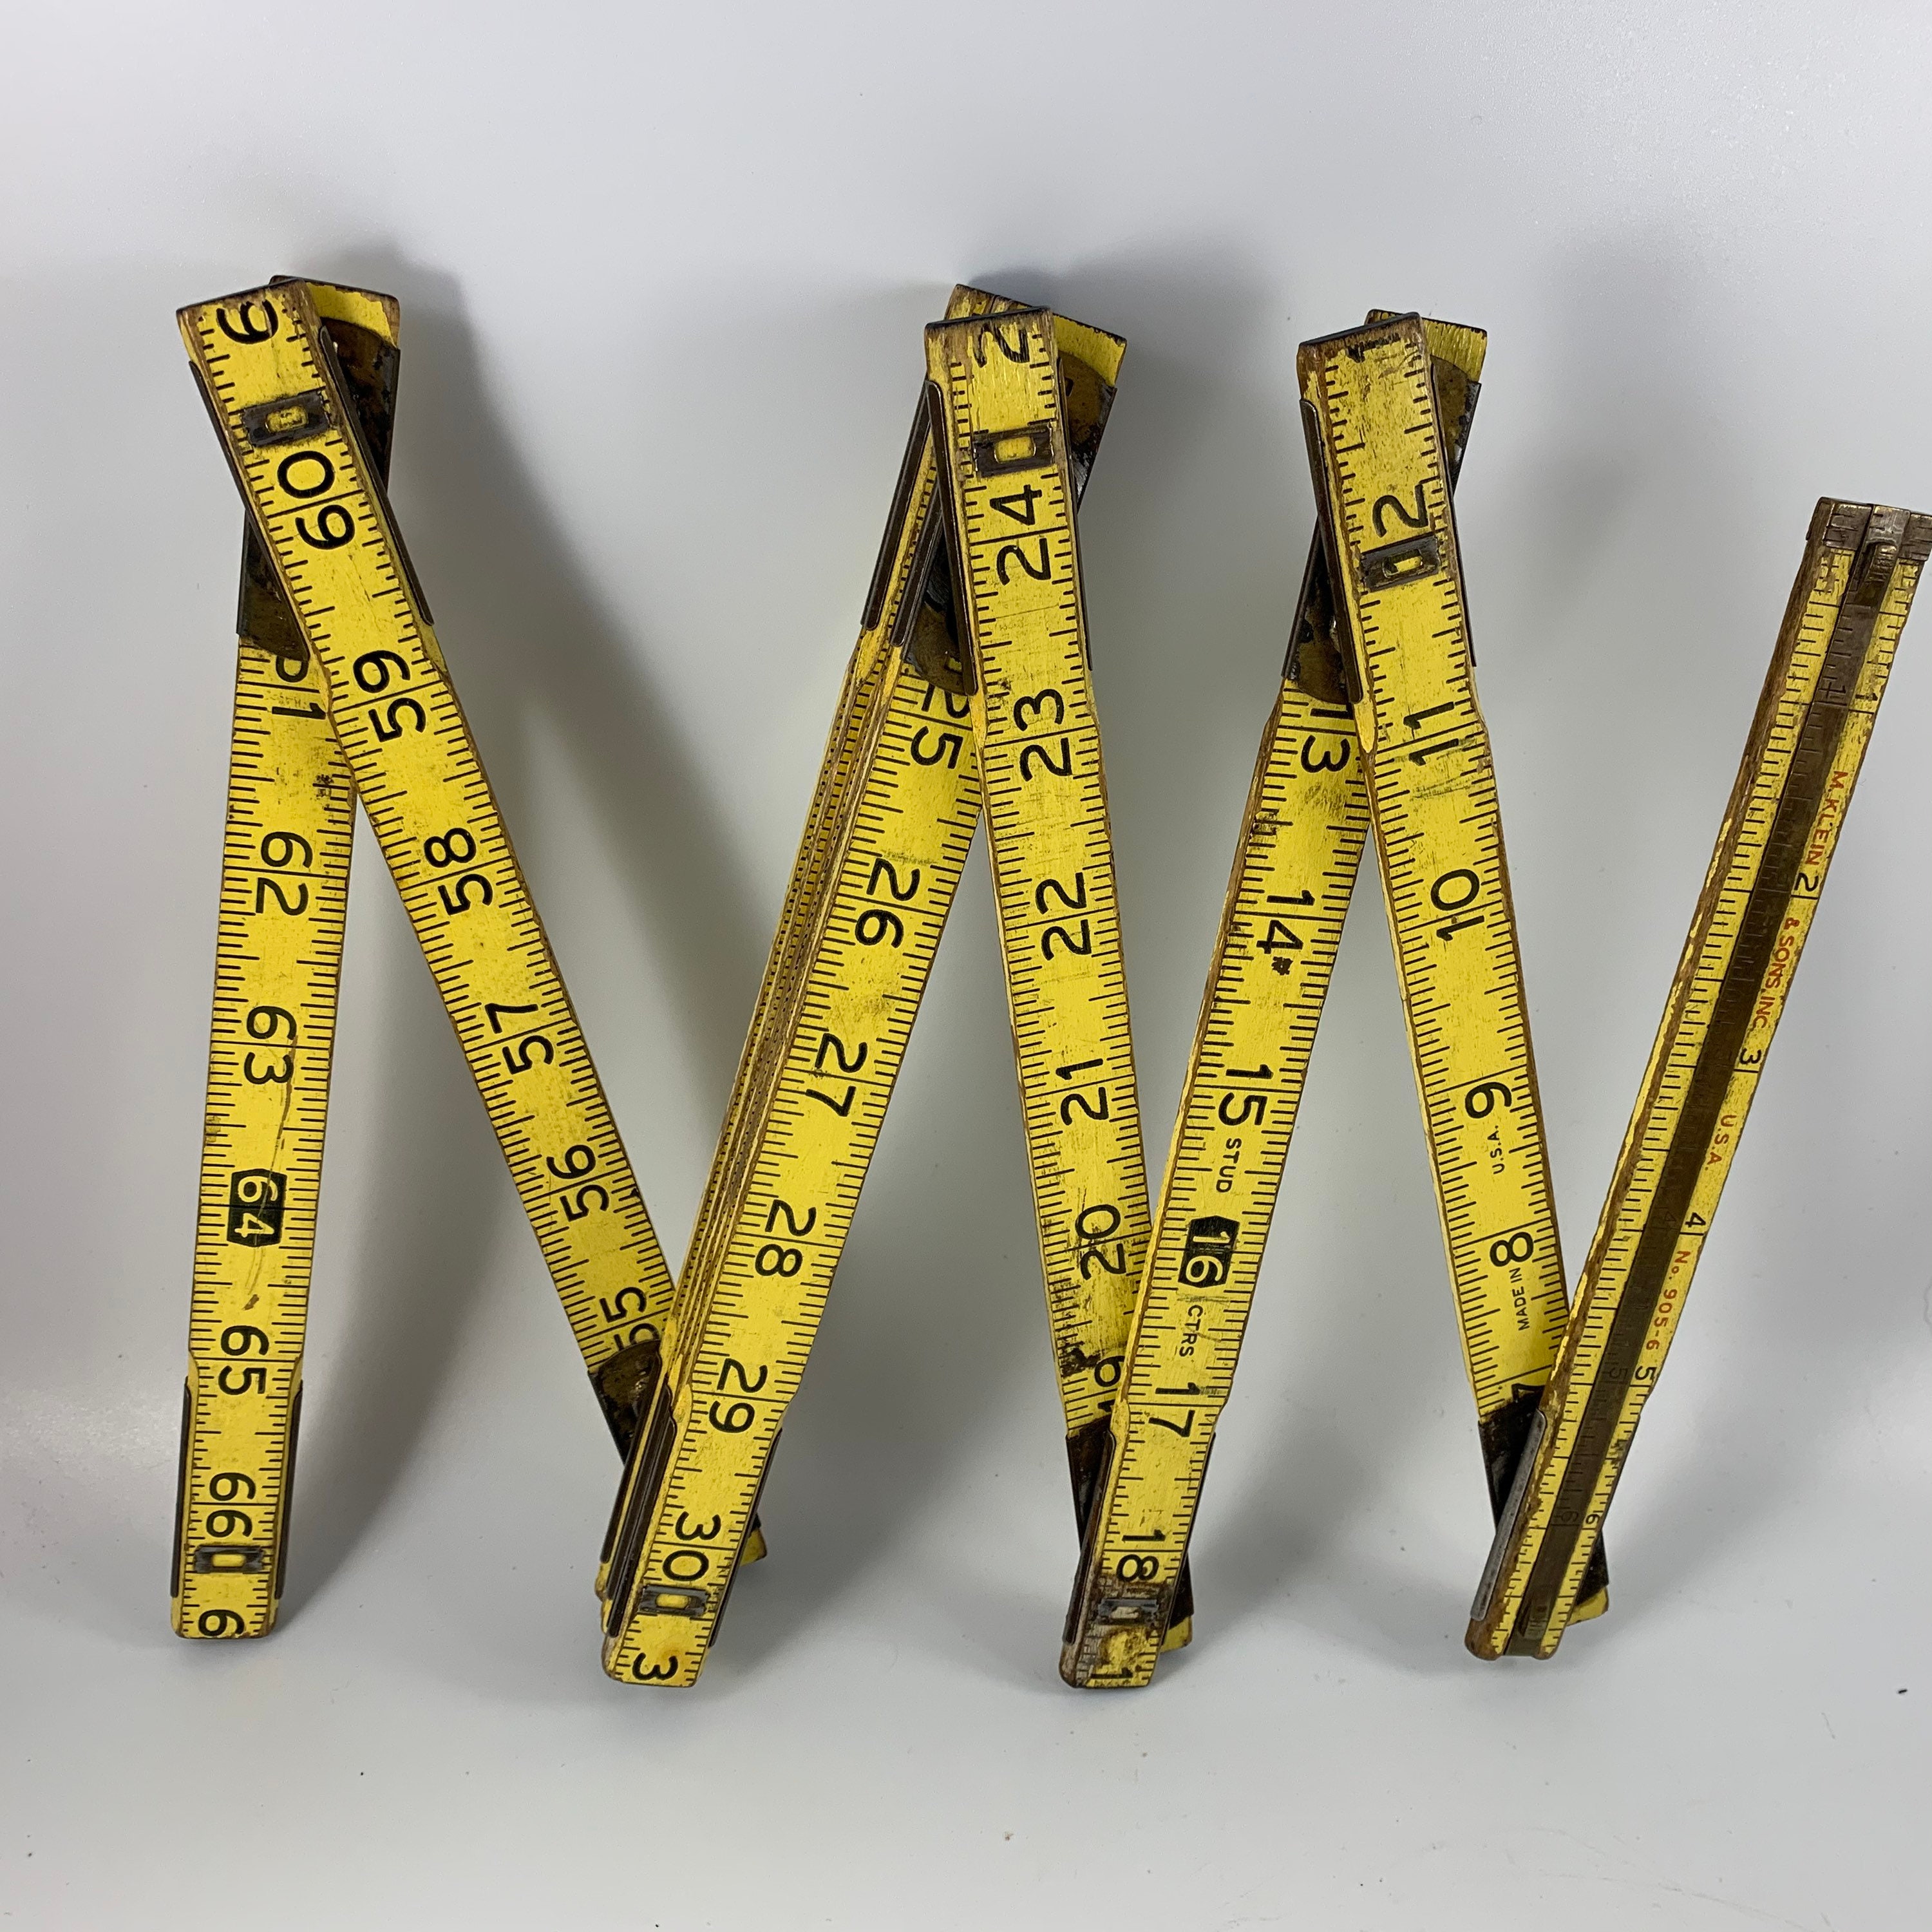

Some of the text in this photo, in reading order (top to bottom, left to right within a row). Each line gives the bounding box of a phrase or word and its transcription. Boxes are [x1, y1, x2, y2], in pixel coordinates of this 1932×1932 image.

[277, 451, 355, 550] 60
[989, 484, 1052, 586] 24
[352, 650, 426, 743] 59
[1013, 688, 1072, 782] 23
[1301, 703, 1352, 773] 13
[1403, 701, 1459, 766] 11
[255, 831, 313, 916] 62
[424, 828, 493, 914] 58
[855, 858, 920, 948] 26
[1794, 873, 1819, 891] 2
[1035, 872, 1092, 961] 22
[1256, 890, 1315, 954] 14
[1430, 868, 1485, 943] 10
[1784, 918, 1800, 929] &
[243, 1005, 297, 1084] 63
[485, 1003, 554, 1075] 57
[1739, 1048, 1762, 1065] 3
[806, 1033, 867, 1117] 27
[1056, 1058, 1110, 1126] 21
[1218, 1063, 1274, 1126] 15
[1465, 1081, 1512, 1119] 9
[1215, 1138, 1242, 1193] STUD
[1487, 1125, 1505, 1175] U.S.A.
[1705, 1114, 1737, 1170] U.S.A.
[232, 1173, 281, 1241] 64
[546, 1144, 609, 1222] 56
[755, 1199, 817, 1278] 28
[1075, 1204, 1127, 1281] 20
[1490, 1231, 1535, 1267] 8
[1685, 1212, 1706, 1227] 4
[1184, 1227, 1233, 1285] 16
[1179, 1304, 1204, 1358] CTRS
[1508, 1266, 1530, 1331] MADE IN
[1646, 1250, 1690, 1350] No. 905-6
[218, 1325, 269, 1396] 65
[1635, 1366, 1657, 1380] 5
[708, 1358, 768, 1434] 29
[1148, 1382, 1200, 1437] 17
[206, 1472, 256, 1539] 66
[1585, 1513, 1600, 1525] 6
[662, 1512, 722, 1582] 30
[1117, 1528, 1166, 1581] 18
[198, 1609, 245, 1636] 6
[632, 1653, 679, 1681] 3
